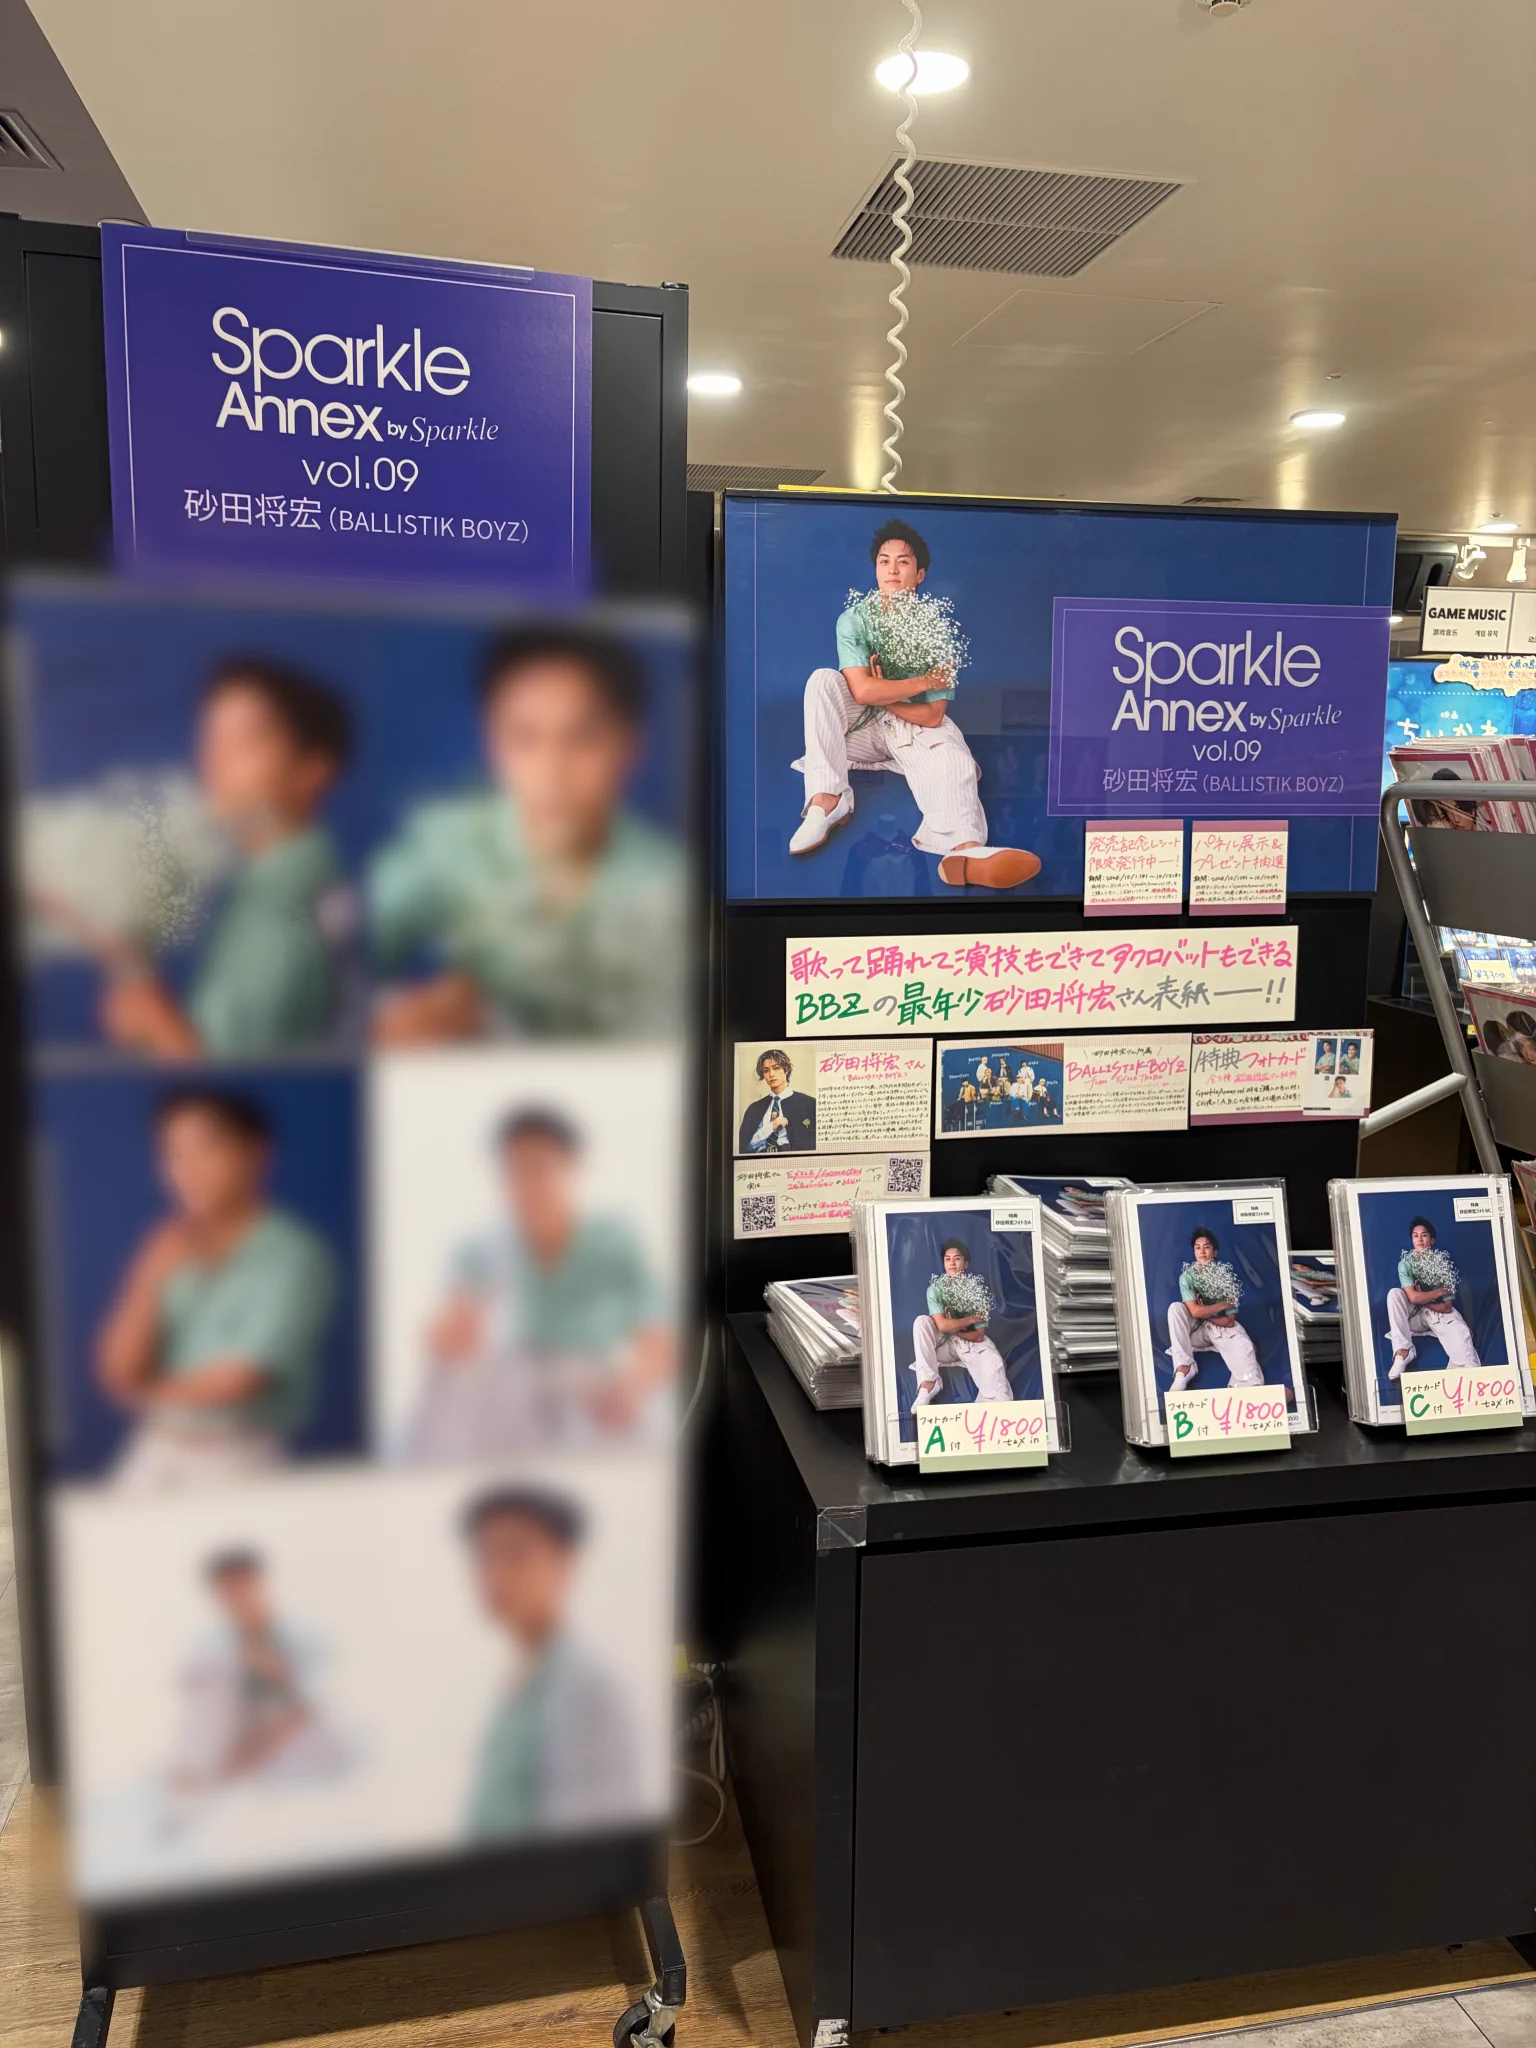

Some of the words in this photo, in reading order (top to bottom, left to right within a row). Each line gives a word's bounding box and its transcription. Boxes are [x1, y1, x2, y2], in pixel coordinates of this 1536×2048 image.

[211, 306, 471, 396] Sparkle
[215, 381, 383, 443] Annex
[387, 421, 408, 440] by
[410, 417, 499, 447] Sparkle
[301, 456, 419, 492] vol.09
[184, 488, 322, 531] 砂田将宏
[461, 517, 530, 545] BOYZ)
[1428, 607, 1466, 620] GAME
[1467, 608, 1507, 621] MUSIC
[1112, 625, 1321, 697] Sparkle
[1111, 689, 1248, 732] Annex
[1250, 713, 1267, 729] by
[1268, 704, 1342, 733] Sparkle
[1192, 740, 1262, 762] vol.09
[1102, 768, 1198, 793] 砂田将宏
[1295, 774, 1344, 794] BOYZ)
[1088, 835, 1181, 855] 発売記念レシート
[1193, 854, 1285, 872] プレゼント抽選
[789, 937, 1293, 985] 歌って踊れて演技もできてアクロバットもできる
[1404, 1382, 1441, 1394] フォトカード
[1168, 1398, 1209, 1411] フォトカード
[1409, 1393, 1431, 1418] C
[1481, 1400, 1502, 1409] tax
[1505, 1398, 1515, 1406] in
[920, 1412, 963, 1425] フォトカード
[1173, 1411, 1194, 1440] B
[1249, 1422, 1271, 1431] tax
[1273, 1420, 1283, 1428] in
[924, 1425, 946, 1454] A
[1003, 1437, 1025, 1447] tax
[1030, 1436, 1040, 1444] in
